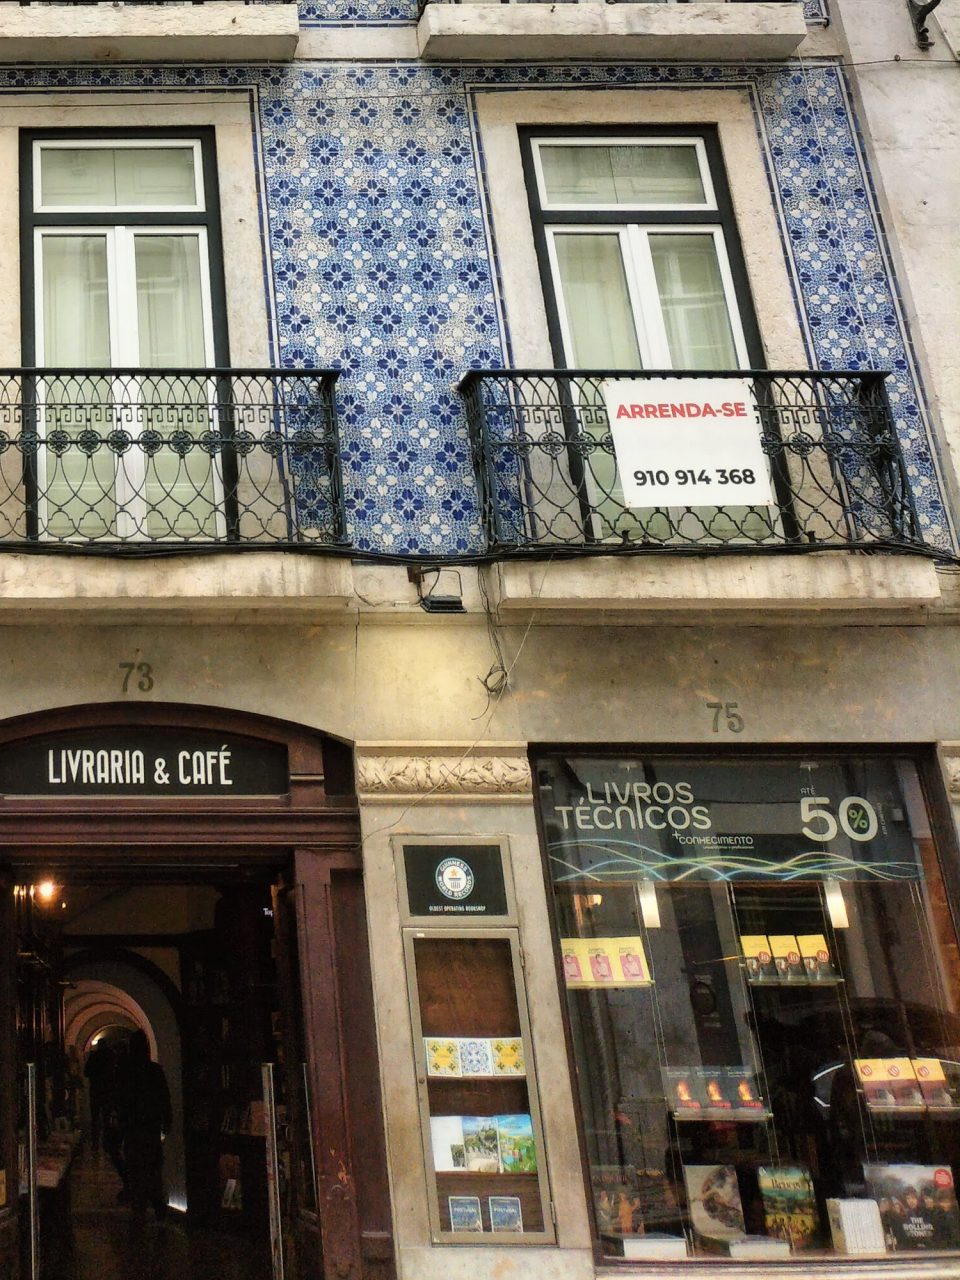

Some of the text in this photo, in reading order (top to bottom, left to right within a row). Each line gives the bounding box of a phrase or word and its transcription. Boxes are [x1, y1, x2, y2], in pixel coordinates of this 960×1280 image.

[616, 402, 748, 419] ARRENDA-SE
[633, 468, 756, 486] 910 914 368
[118, 662, 154, 692] 73
[706, 702, 745, 733] 75
[48, 744, 233, 785] LIVRARIA & CAFÉ
[586, 782, 694, 804] LIVROS
[800, 786, 816, 795] ATÉ
[554, 796, 712, 830] TÉCNICOS
